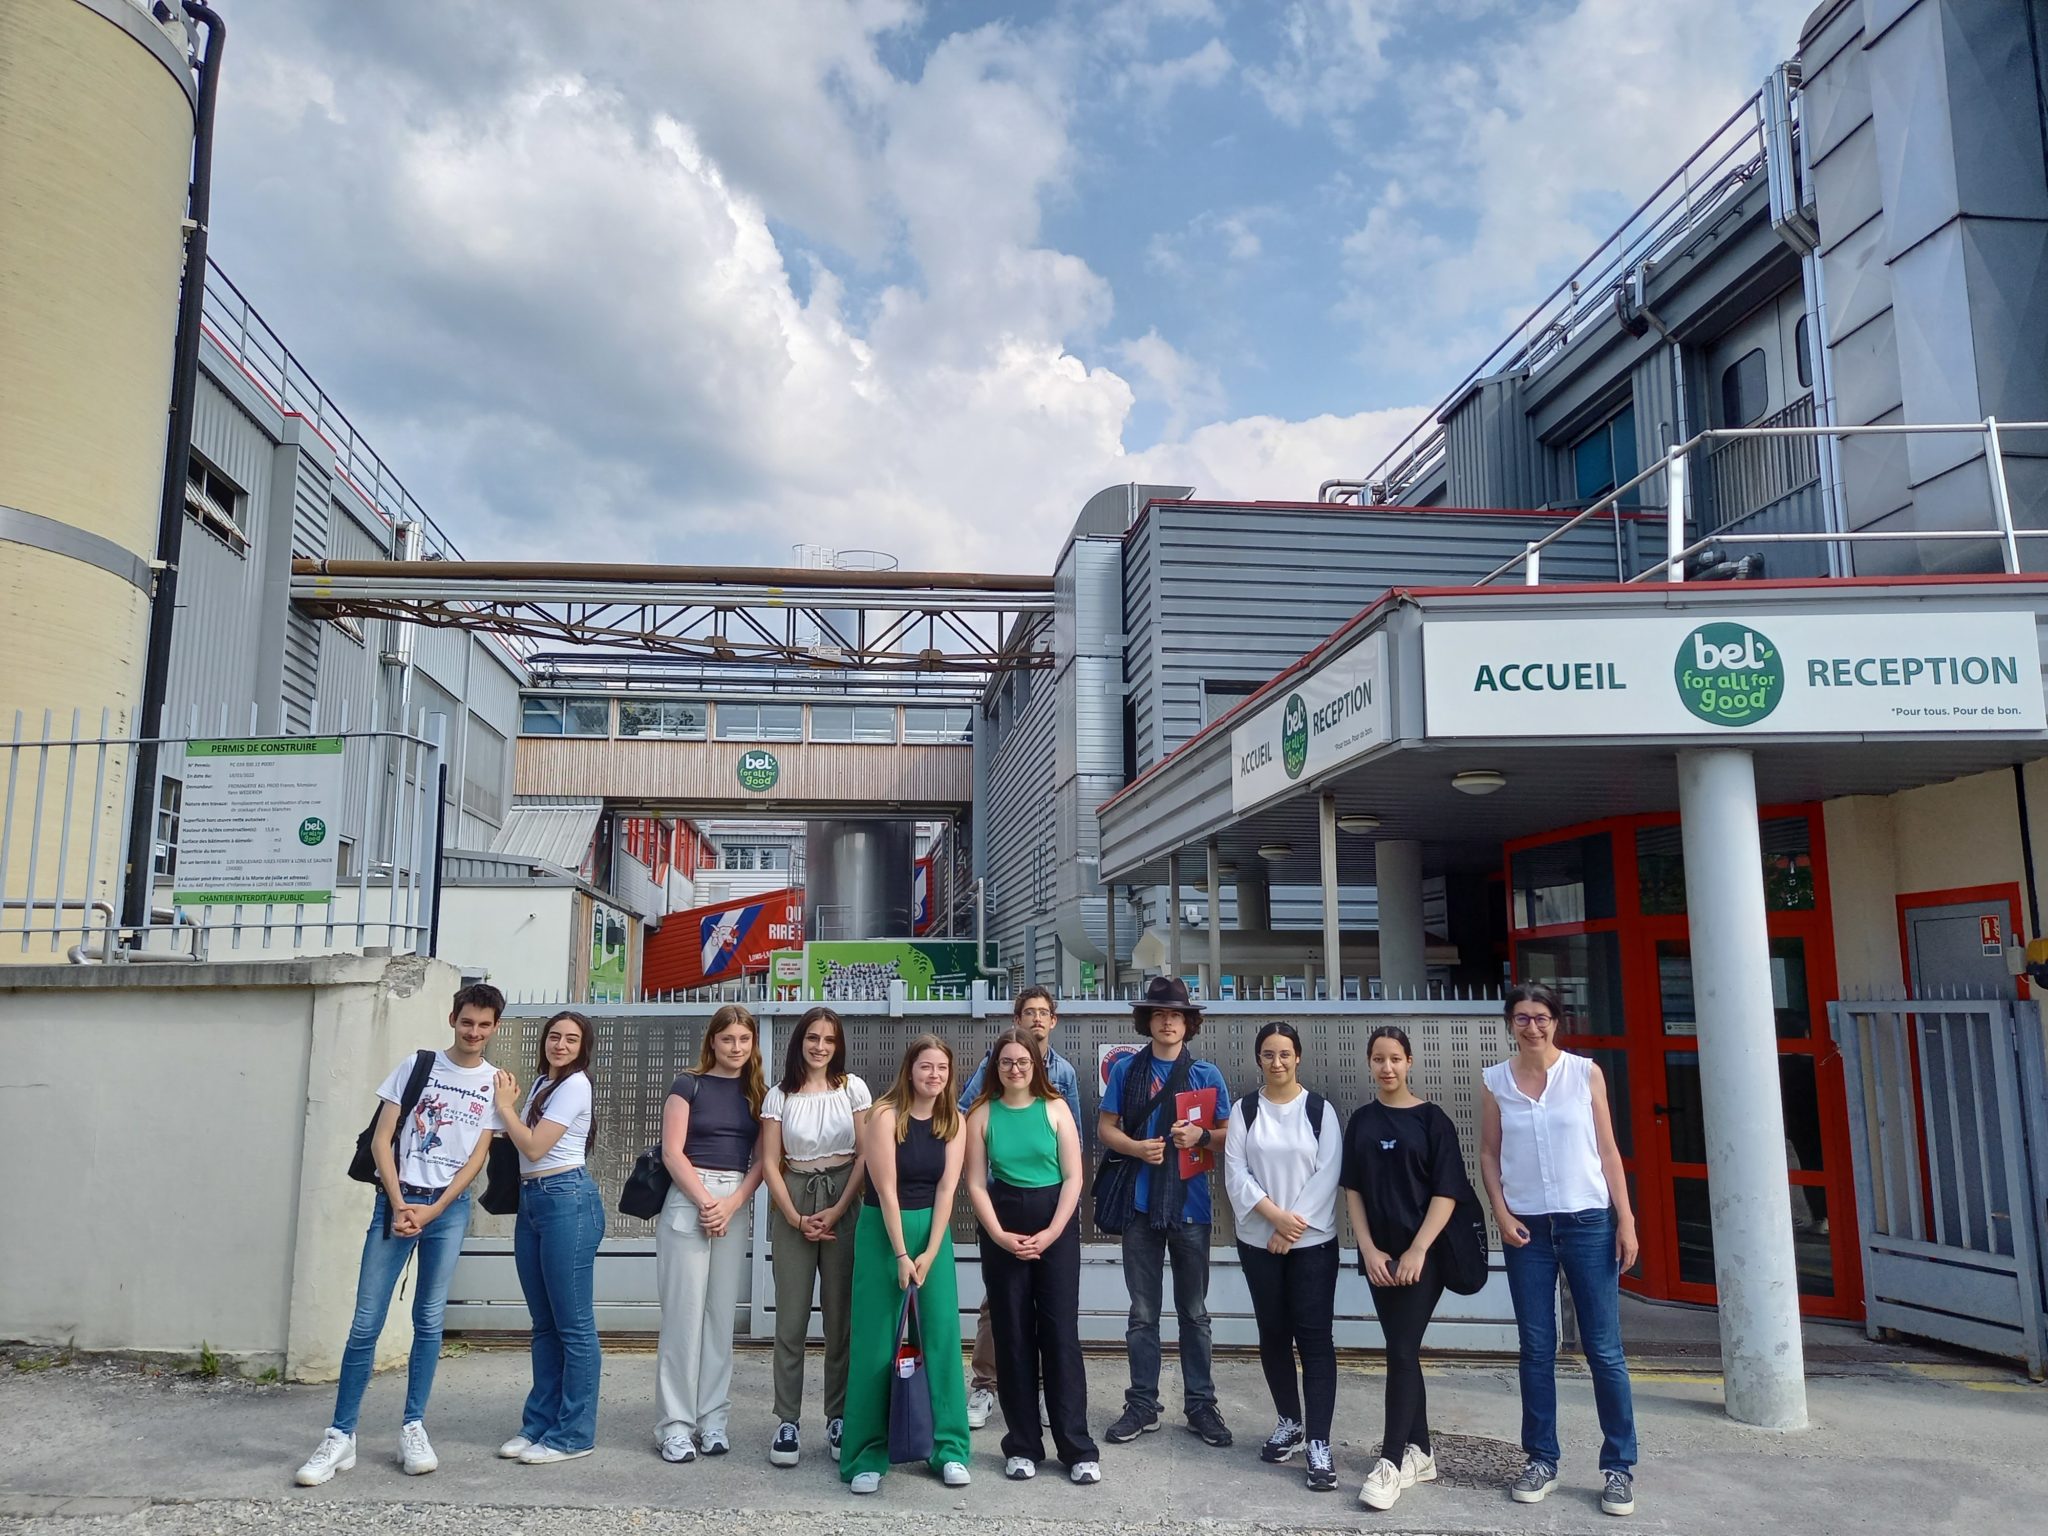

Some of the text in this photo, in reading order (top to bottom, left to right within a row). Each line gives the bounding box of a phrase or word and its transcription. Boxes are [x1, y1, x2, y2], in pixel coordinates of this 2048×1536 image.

[1694, 632, 1765, 670] bel
[1473, 656, 2018, 692] ACCUEIL RECEPTION
[1683, 670, 1775, 690] for all for
[1698, 687, 1766, 712] good
[1286, 699, 1304, 736] bel
[1924, 707, 1950, 716] tous.
[1953, 706, 1978, 715] Pour
[1981, 706, 1995, 715] de
[1997, 706, 2022, 715] bon.
[1240, 678, 1372, 778] ACCUEIL RECEPTION
[211, 742, 318, 753] PERMIS DE CONSTRUIRE
[745, 754, 772, 769] bel
[740, 768, 752, 776] for
[753, 769, 766, 778] all
[745, 775, 772, 785] good
[199, 893, 305, 902] CHANTIER INTERDIT AU PUBLIC
